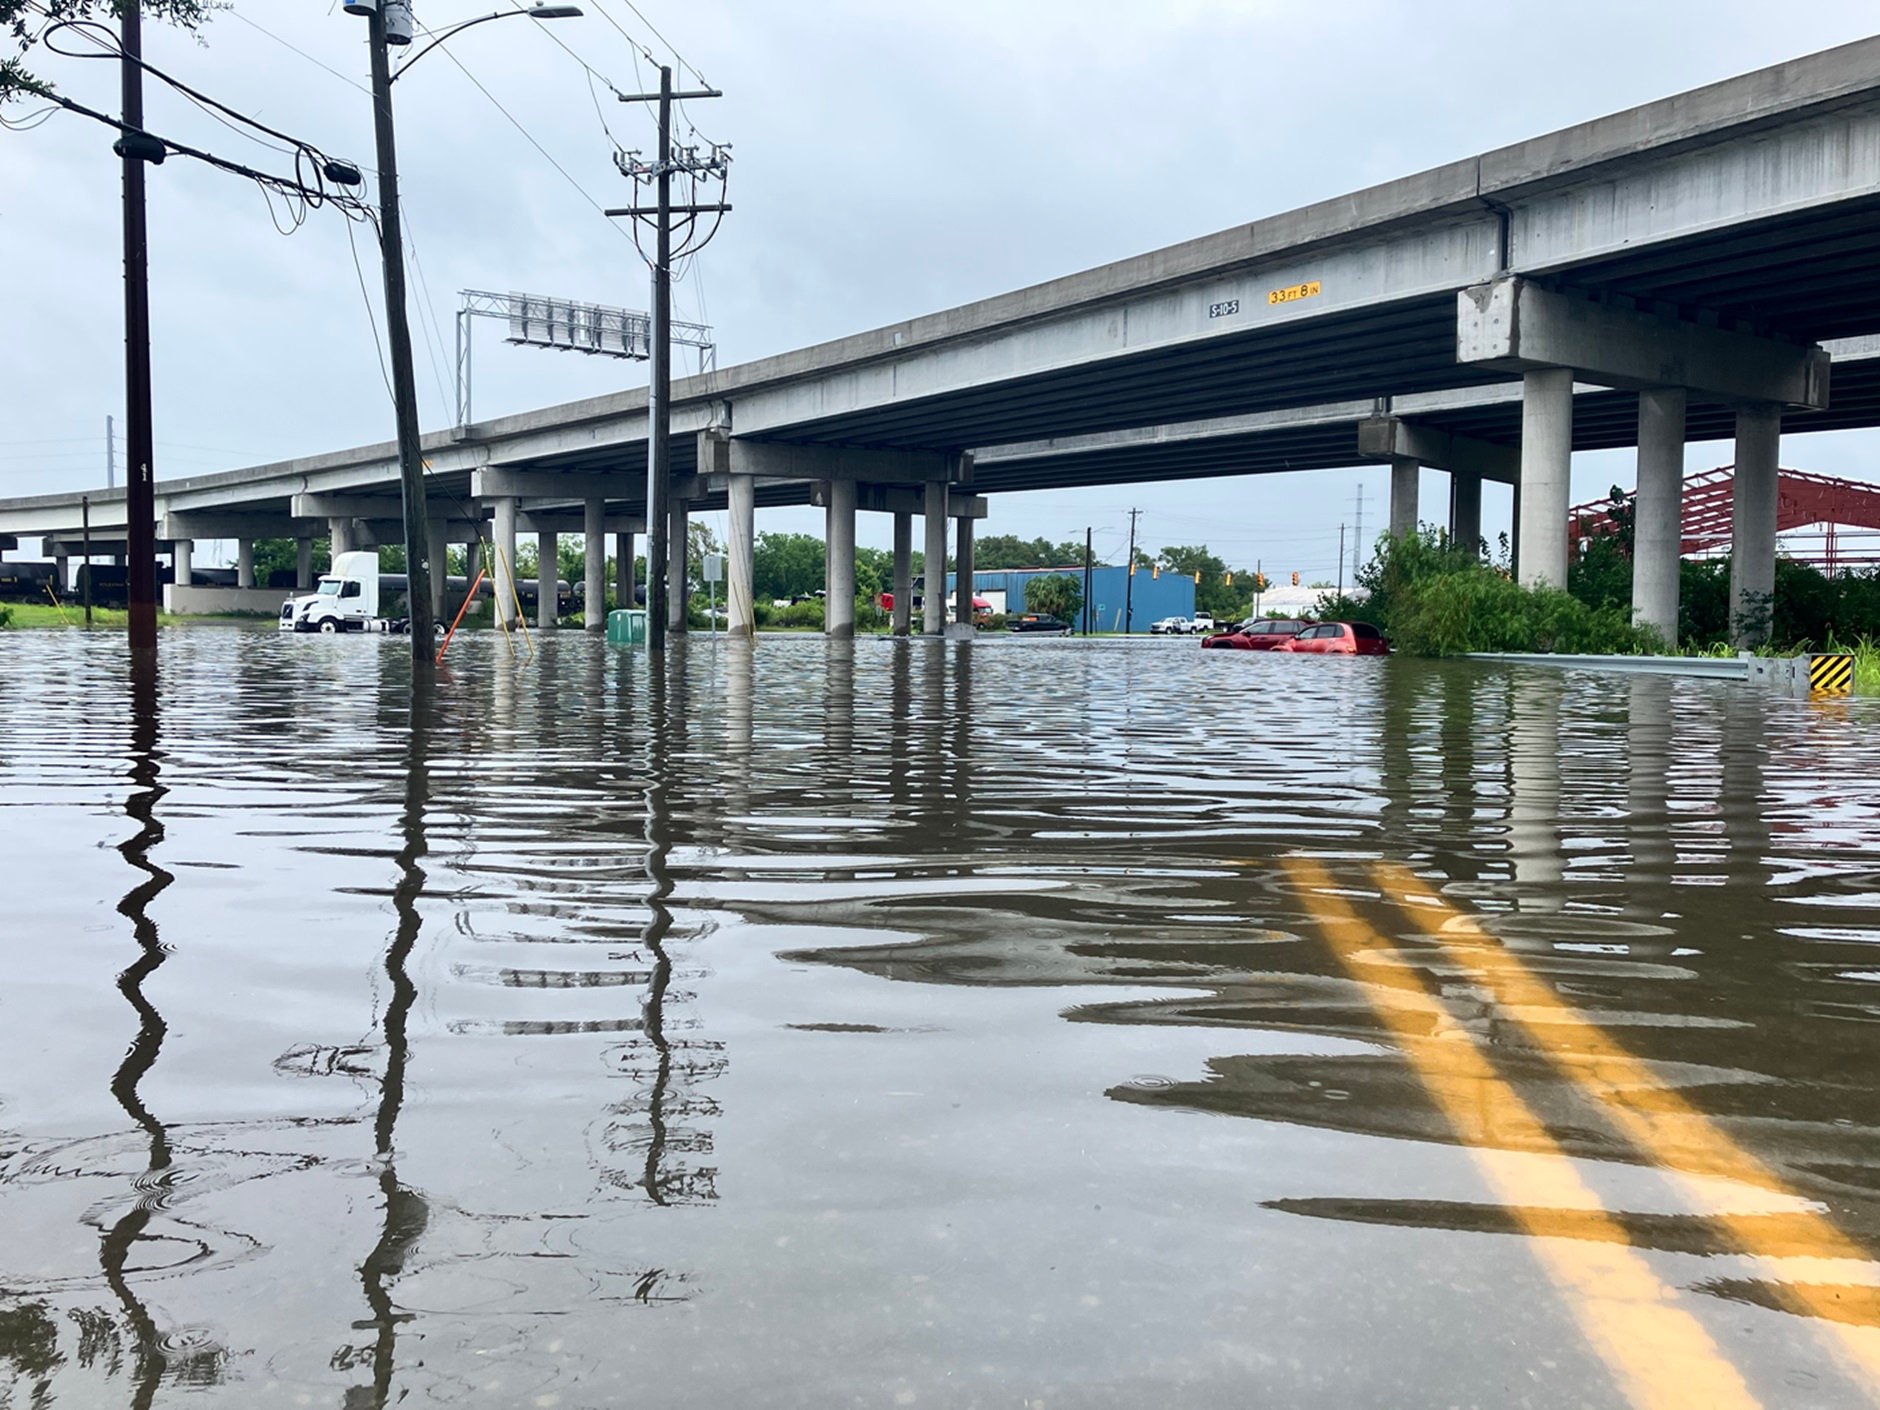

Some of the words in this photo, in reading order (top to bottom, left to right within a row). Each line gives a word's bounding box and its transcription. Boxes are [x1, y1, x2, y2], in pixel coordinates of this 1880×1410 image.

[1271, 290, 1286, 304] 33
[1287, 290, 1297, 300] FT
[1300, 284, 1309, 297] 8
[1310, 285, 1319, 295] IN
